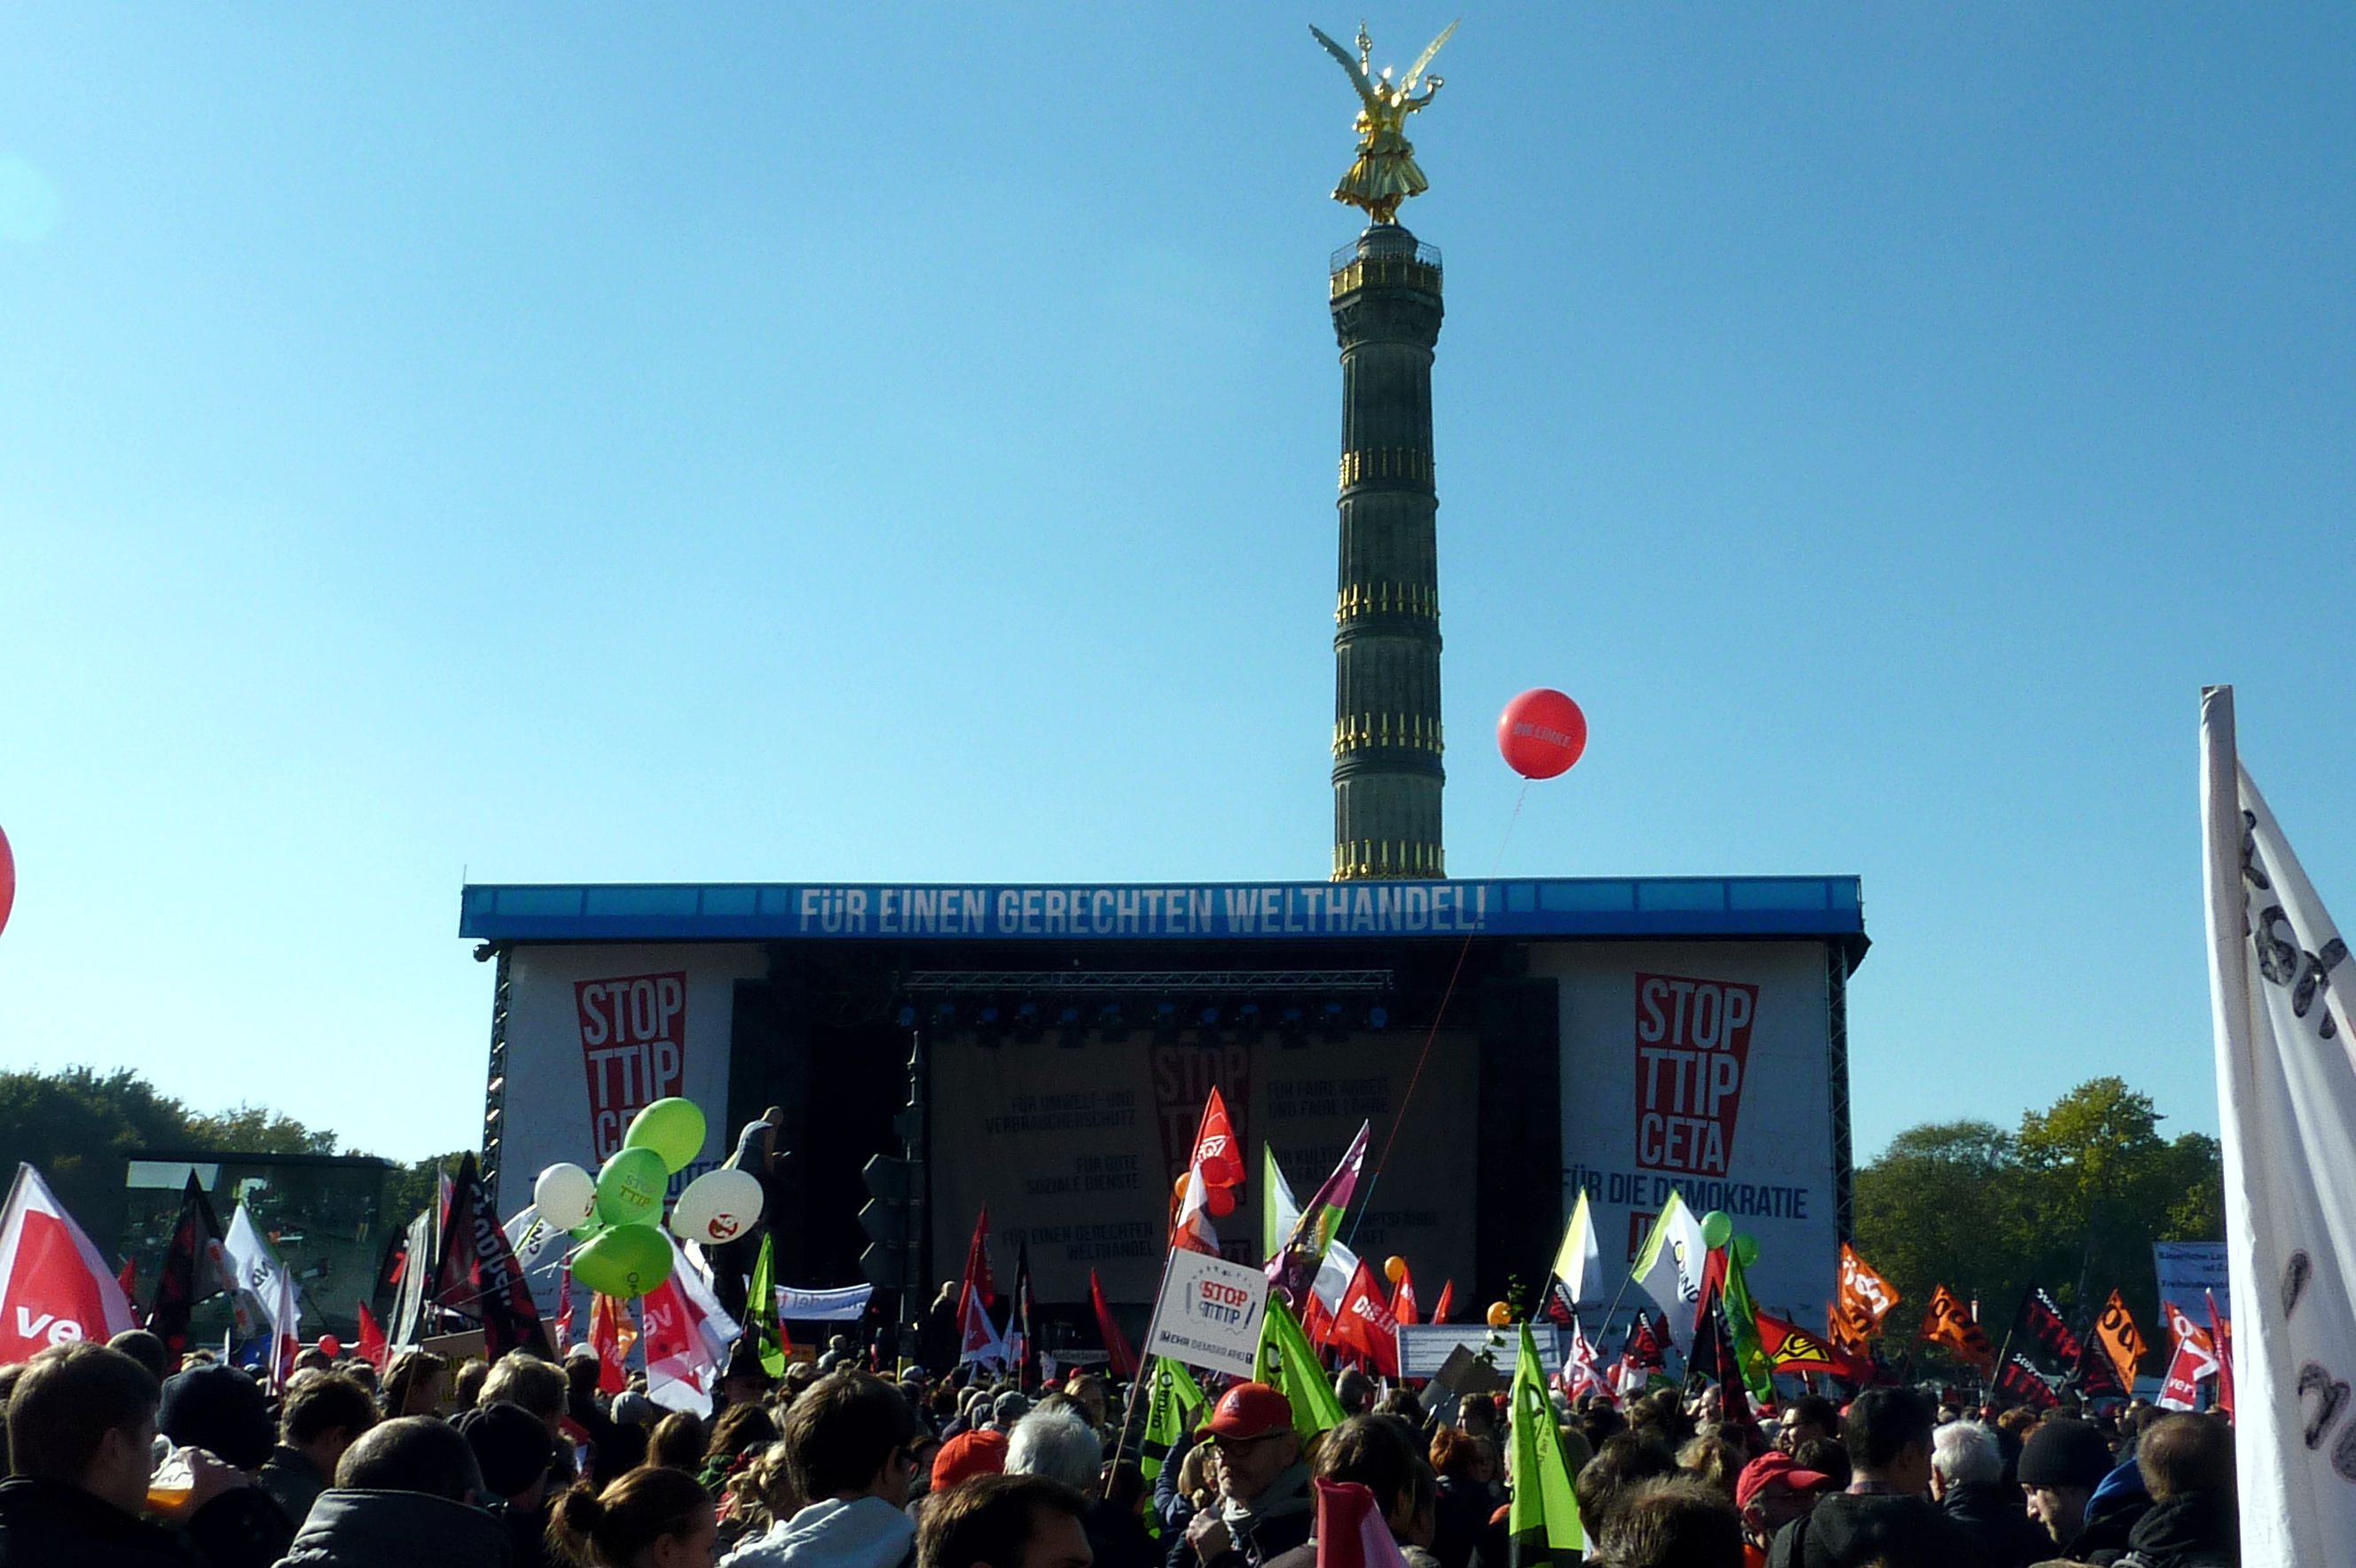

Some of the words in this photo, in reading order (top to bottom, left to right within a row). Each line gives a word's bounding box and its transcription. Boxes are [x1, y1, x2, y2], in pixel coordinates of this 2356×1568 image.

[800, 889, 867, 934] FÜR
[879, 888, 986, 934] EINEN
[998, 887, 1211, 934] GERECHTEN
[1225, 885, 1485, 933] WELTHANDEL!
[583, 977, 682, 1047] STOP
[1639, 979, 1751, 1050] STOP
[588, 1040, 680, 1109] TTIP
[1640, 1047, 1739, 1118] TTIP
[1640, 1113, 1725, 1173] CETA
[1562, 1163, 1602, 1202] FÜR
[1608, 1172, 1645, 1205] DIE
[1652, 1176, 1809, 1219] DEMOKRATIE
[1200, 1281, 1248, 1306] STOP
